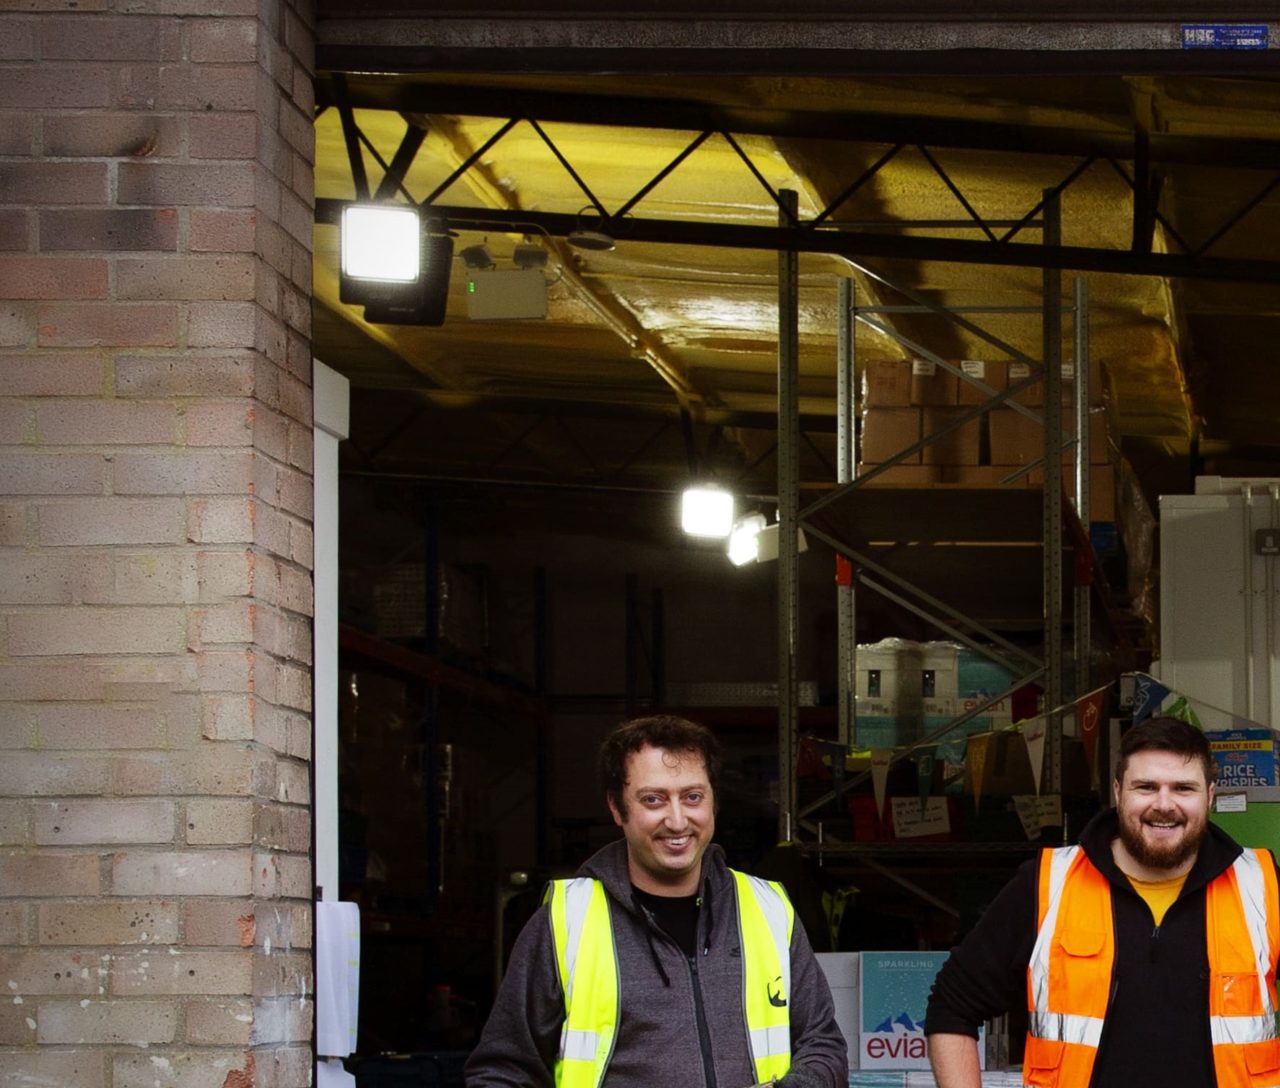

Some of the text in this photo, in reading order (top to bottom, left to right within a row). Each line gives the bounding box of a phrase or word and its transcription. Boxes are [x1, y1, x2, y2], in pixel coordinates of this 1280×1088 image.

[1223, 764, 1255, 777] RICE
[878, 959, 934, 968] SPARKLING
[867, 1033, 926, 1058] evia
